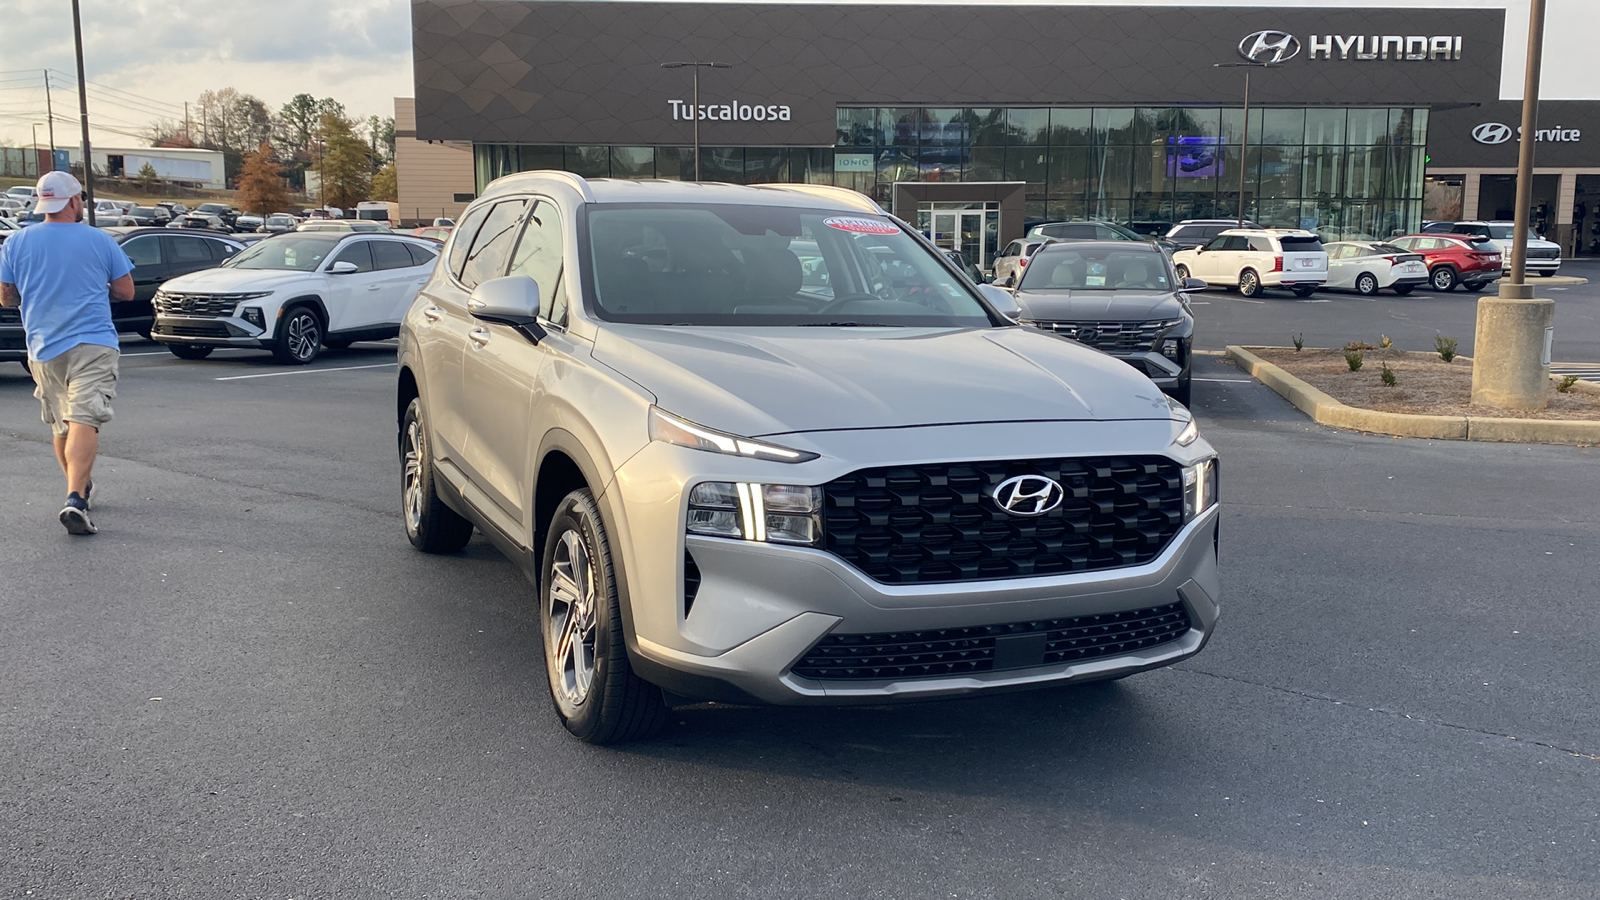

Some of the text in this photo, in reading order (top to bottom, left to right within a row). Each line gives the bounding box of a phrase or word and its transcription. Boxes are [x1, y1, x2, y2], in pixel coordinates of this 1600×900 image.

[1308, 35, 1462, 60] HYUNDAI
[668, 100, 791, 121] Tuscaloosa
[1517, 125, 1580, 142] rvice
